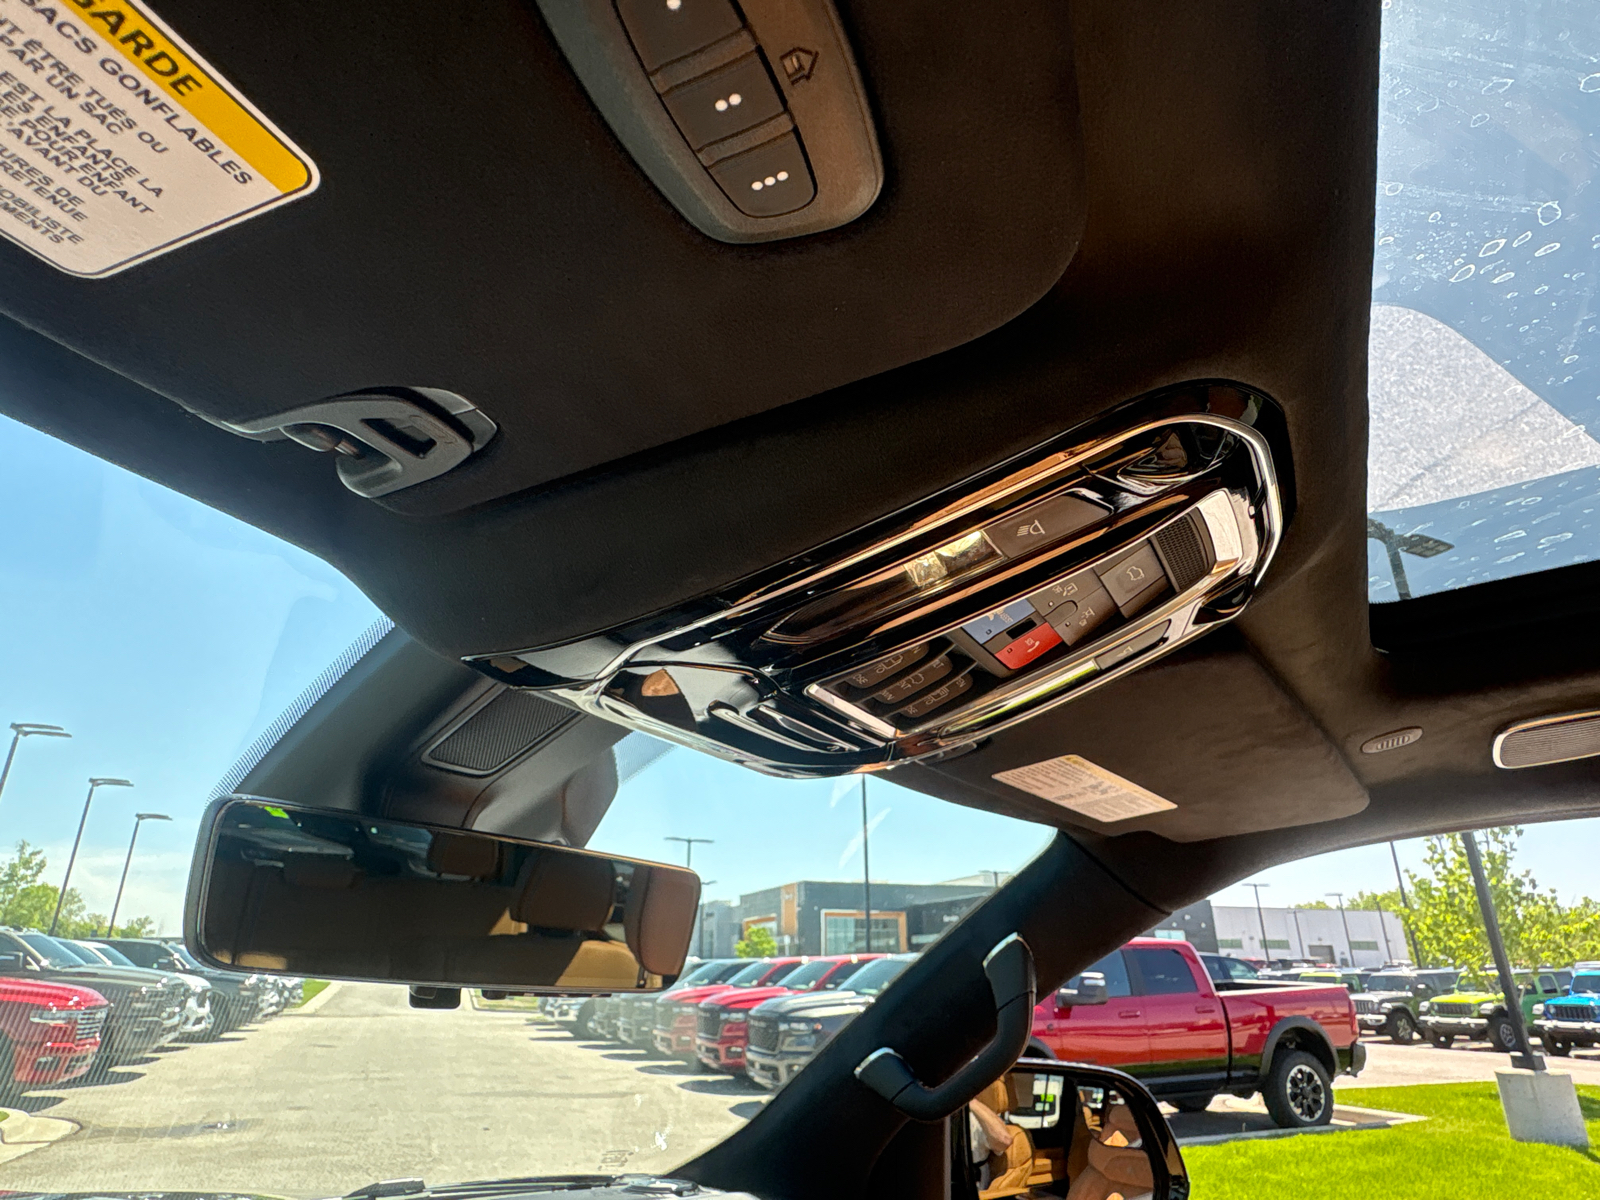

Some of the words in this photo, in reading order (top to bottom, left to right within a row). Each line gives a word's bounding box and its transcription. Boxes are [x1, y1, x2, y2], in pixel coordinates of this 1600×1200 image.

[72, 0, 203, 96] ARDE
[0, 34, 45, 74] PAR
[46, 73, 80, 100] UN
[79, 102, 125, 136] SAC
[0, 71, 45, 102] EST
[44, 105, 71, 129] LA
[75, 128, 141, 178] PLACE
[138, 177, 165, 199] LA
[85, 86, 137, 130] TUÉS
[138, 131, 170, 154] OU
[99, 58, 253, 185] GONFLABLES
[0, 144, 54, 187] URES
[54, 186, 86, 208] DE
[0, 160, 89, 222] RETENUE
[18, 118, 80, 162] POUR
[79, 163, 155, 215] ENFANT
[77, 175, 109, 197] DU
[0, 186, 85, 244] OBILISTE
[0, 198, 65, 244] MENTS
